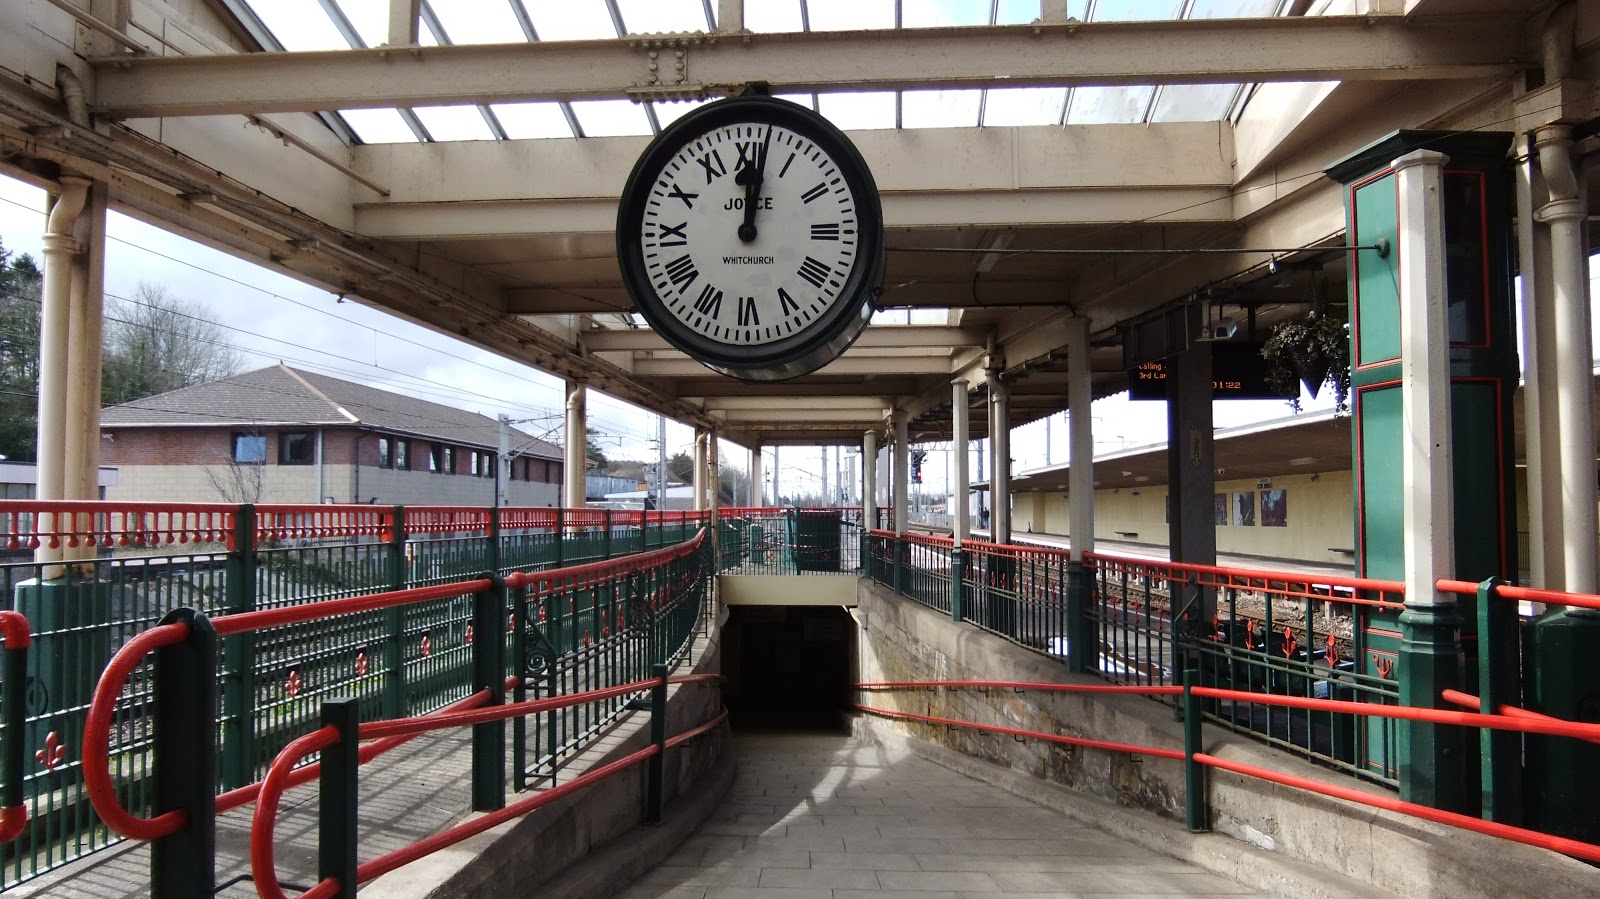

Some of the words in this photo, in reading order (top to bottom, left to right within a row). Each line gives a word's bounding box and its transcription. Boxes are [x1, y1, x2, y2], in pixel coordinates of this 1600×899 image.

[696, 149, 727, 185] XI
[734, 141, 764, 171] XII
[779, 153, 796, 178] I
[668, 183, 699, 210] X
[724, 197, 773, 210] JOCE
[801, 182, 830, 205] II
[659, 221, 687, 247] IX
[810, 223, 839, 240] III
[664, 253, 700, 295] VIII
[722, 256, 774, 265] WHITCHURCH
[796, 256, 832, 289] IIII
[693, 283, 723, 320] VII
[737, 296, 760, 326] VI
[777, 287, 800, 316] V
